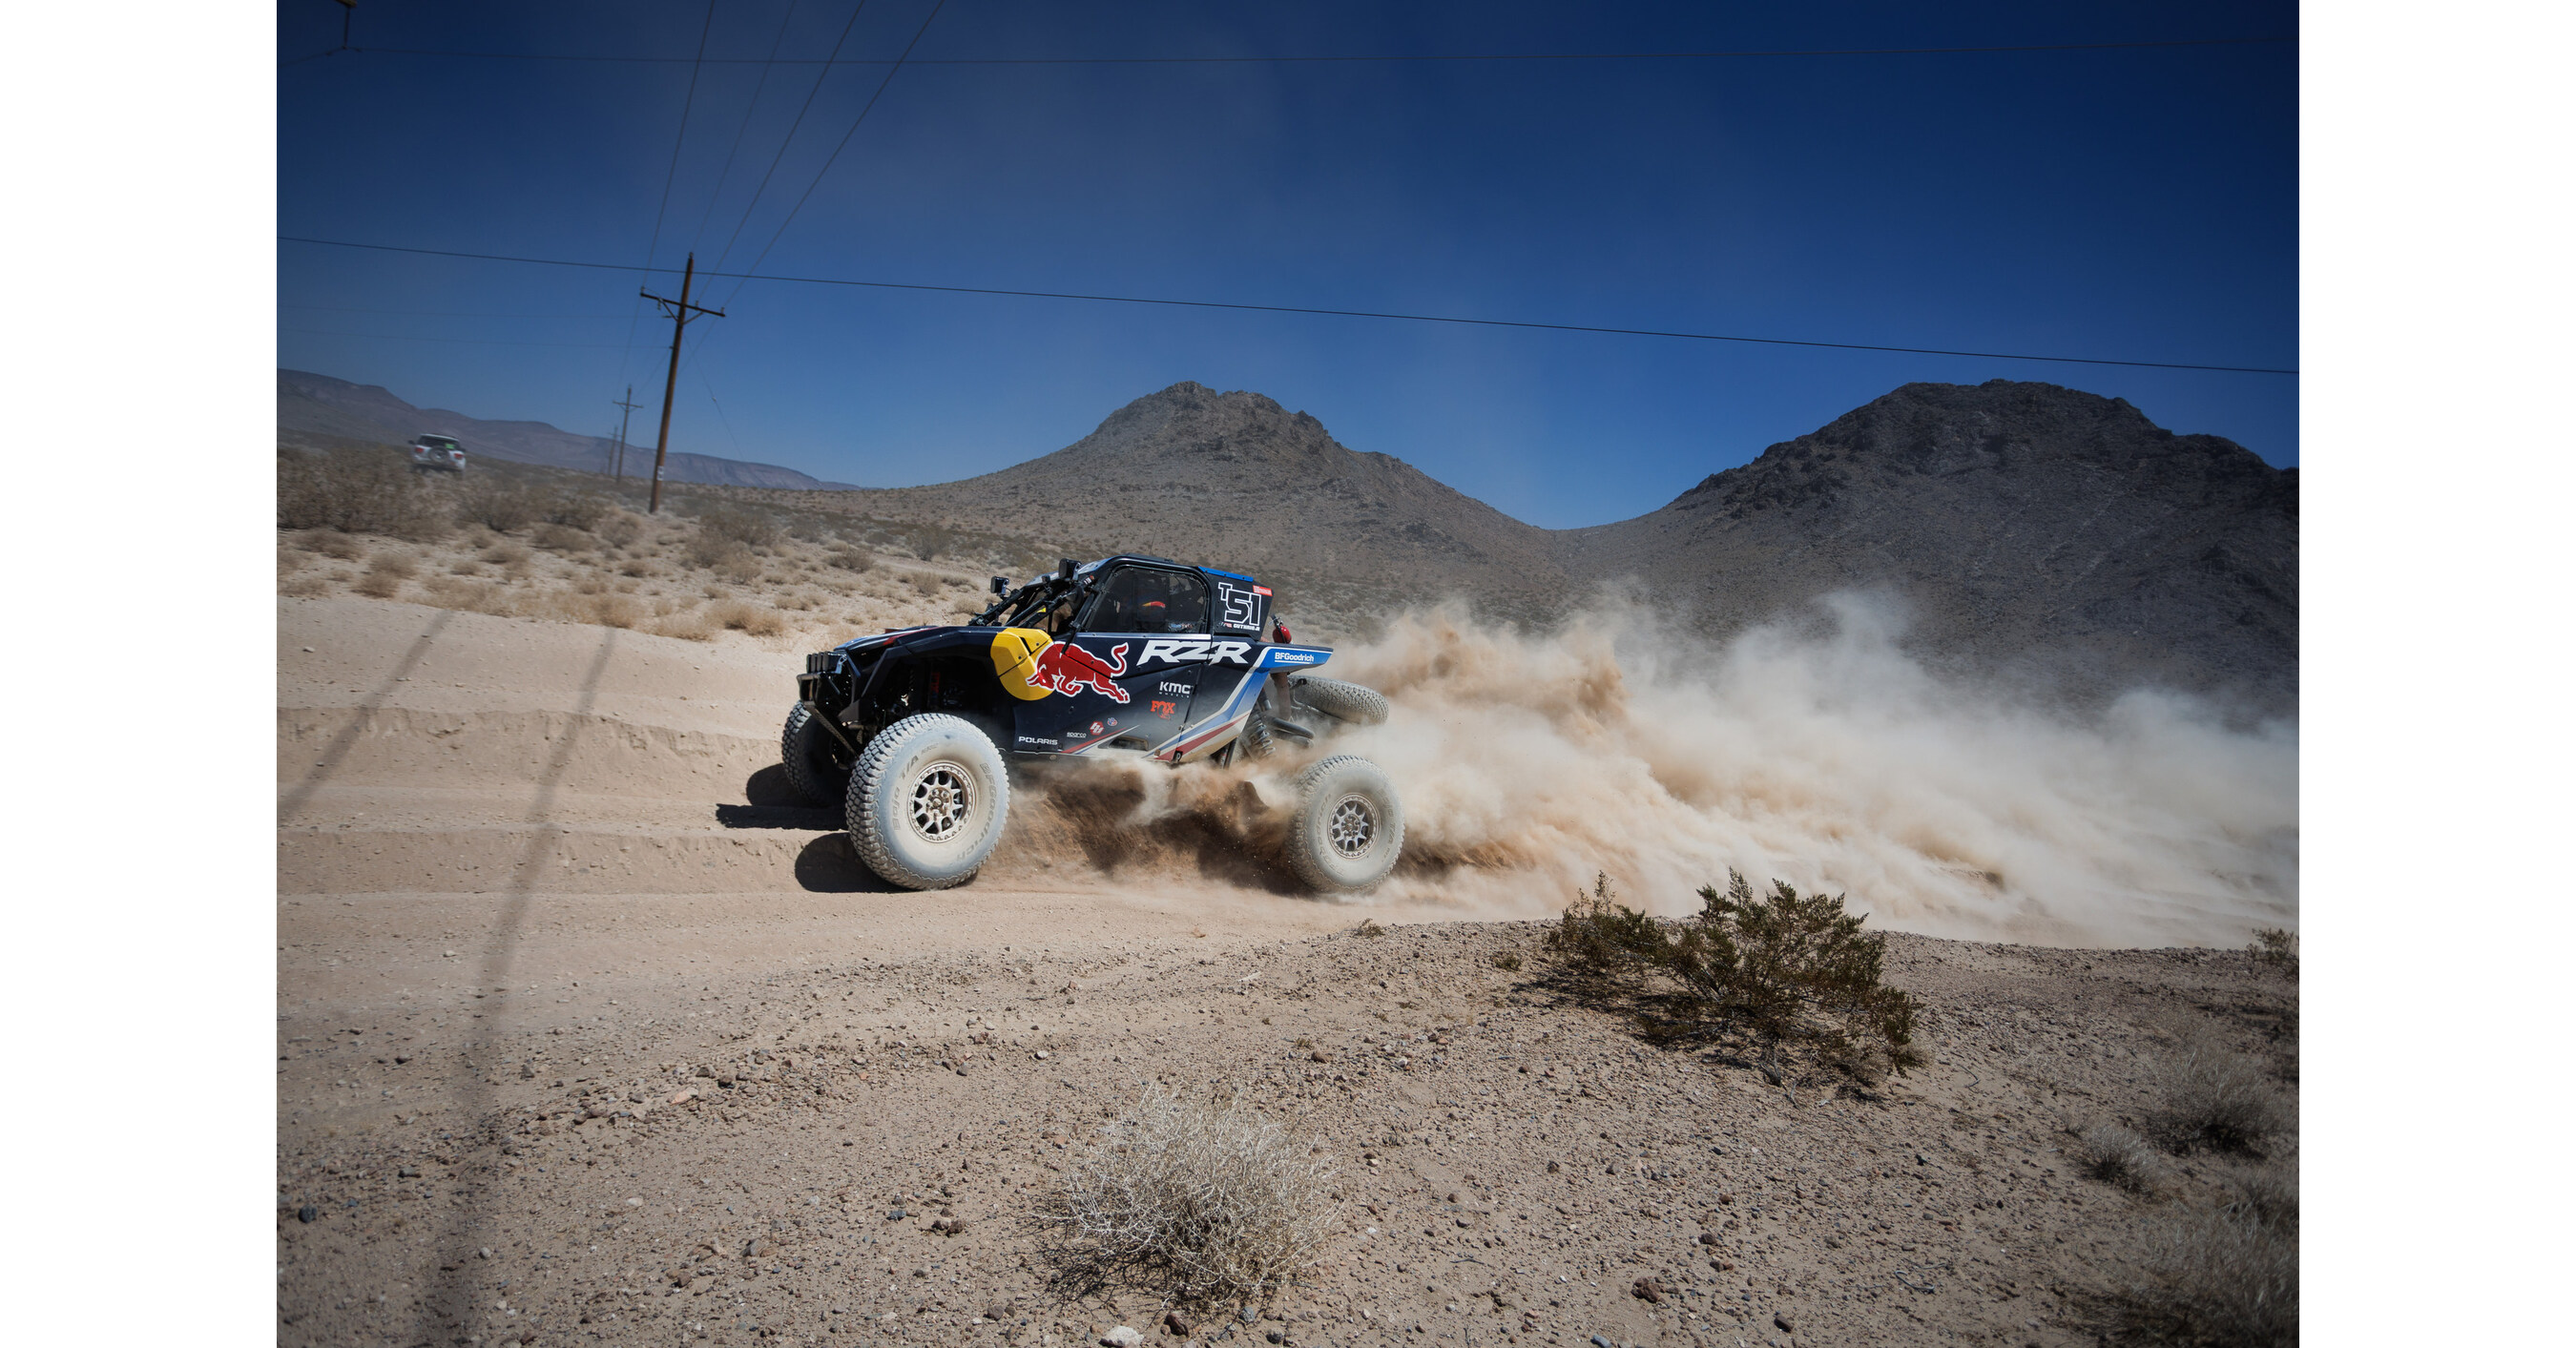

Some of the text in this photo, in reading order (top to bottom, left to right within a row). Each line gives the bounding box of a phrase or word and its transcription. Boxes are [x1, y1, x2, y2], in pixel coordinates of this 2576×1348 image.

[1136, 640, 1252, 666] RZR
[1275, 652, 1315, 662] BFGoodrich
[1159, 681, 1191, 695] KMC
[1150, 700, 1175, 715] FOX
[1018, 736, 1058, 746] POLARIS
[957, 762, 998, 863] BFGoodrich
